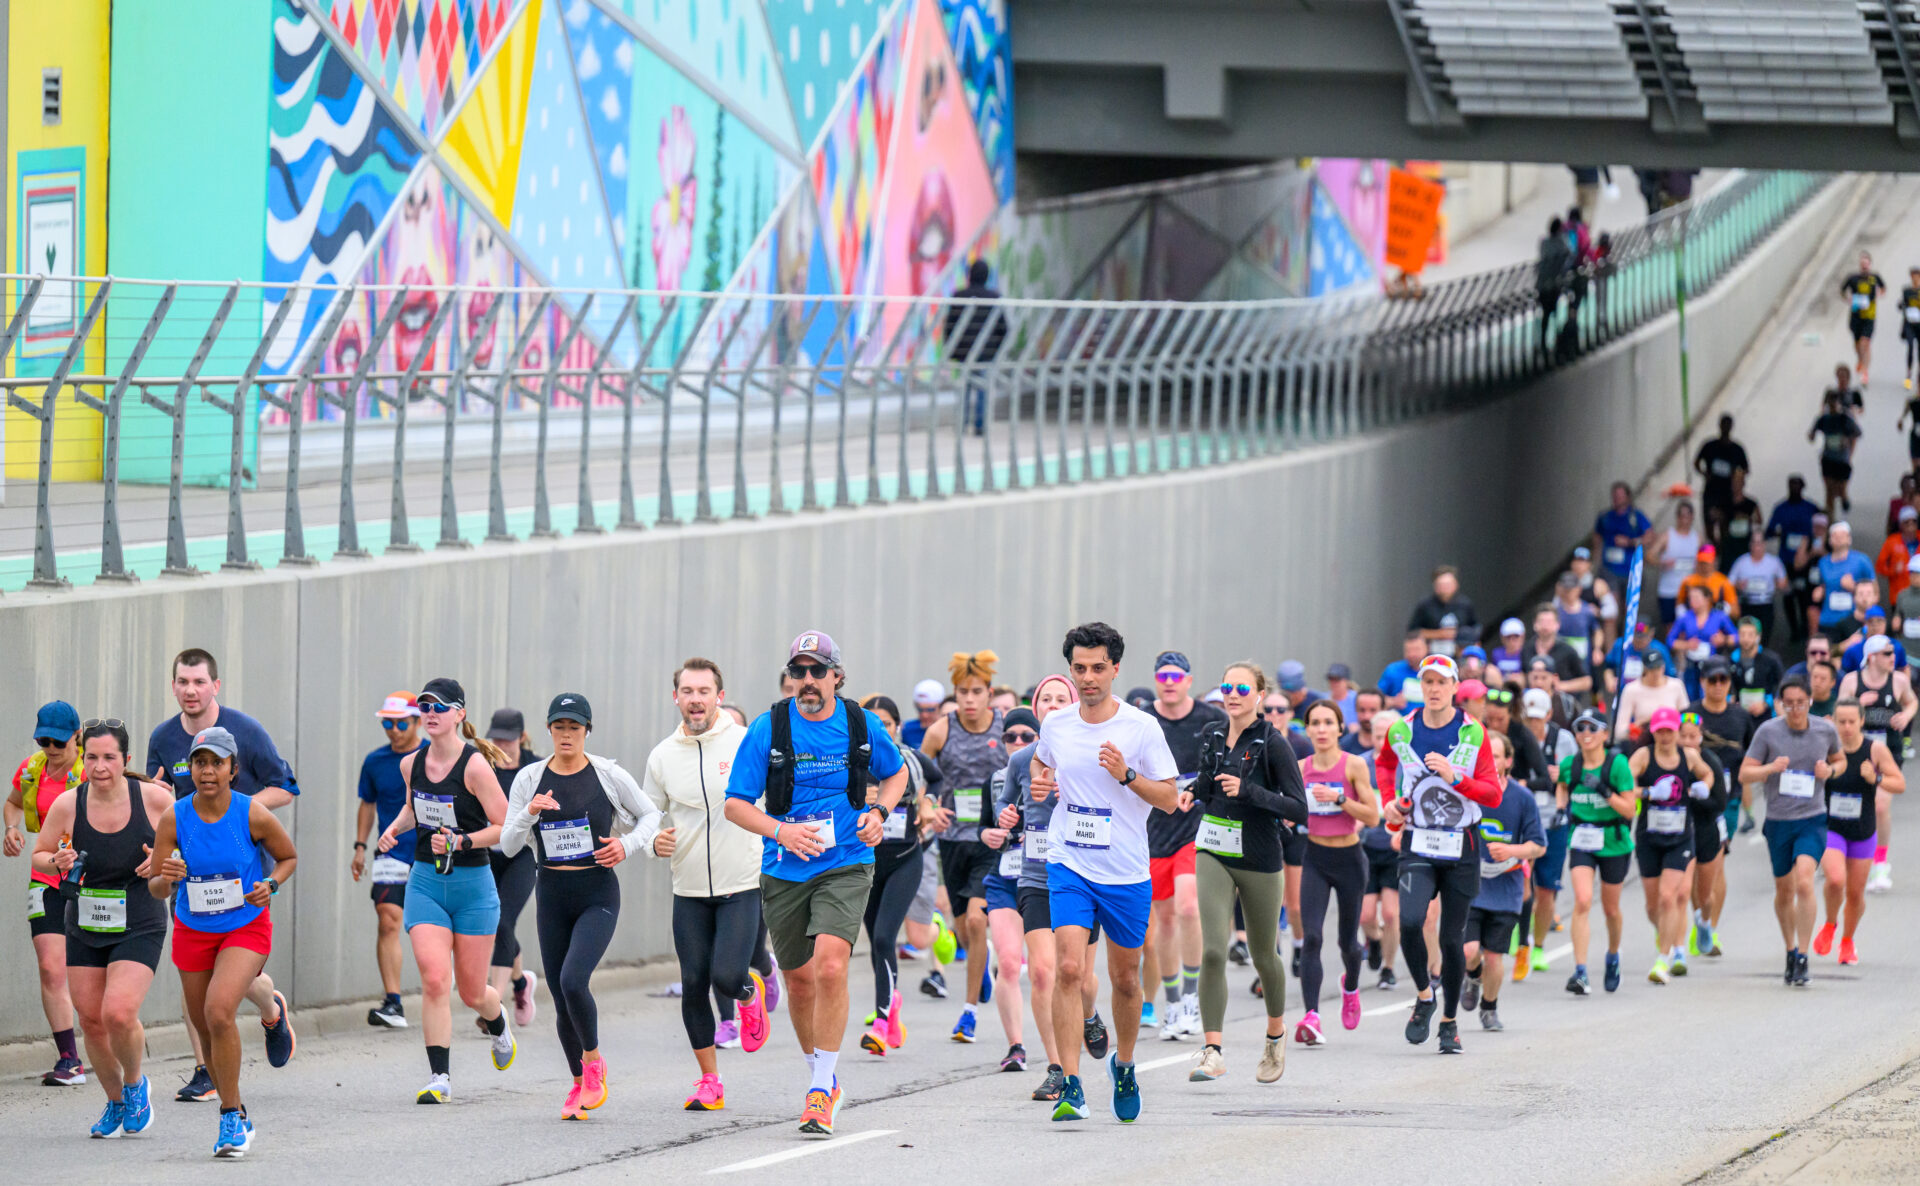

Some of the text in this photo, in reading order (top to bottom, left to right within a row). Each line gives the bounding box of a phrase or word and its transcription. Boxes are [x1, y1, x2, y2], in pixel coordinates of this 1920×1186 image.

[1075, 830, 1096, 839] MAHDI
[555, 841, 582, 852] HEATHER
[1203, 837, 1221, 847] ALISON
[203, 888, 224, 896] 5592
[206, 897, 225, 906] NIDHI
[91, 914, 112, 922] AMBER
